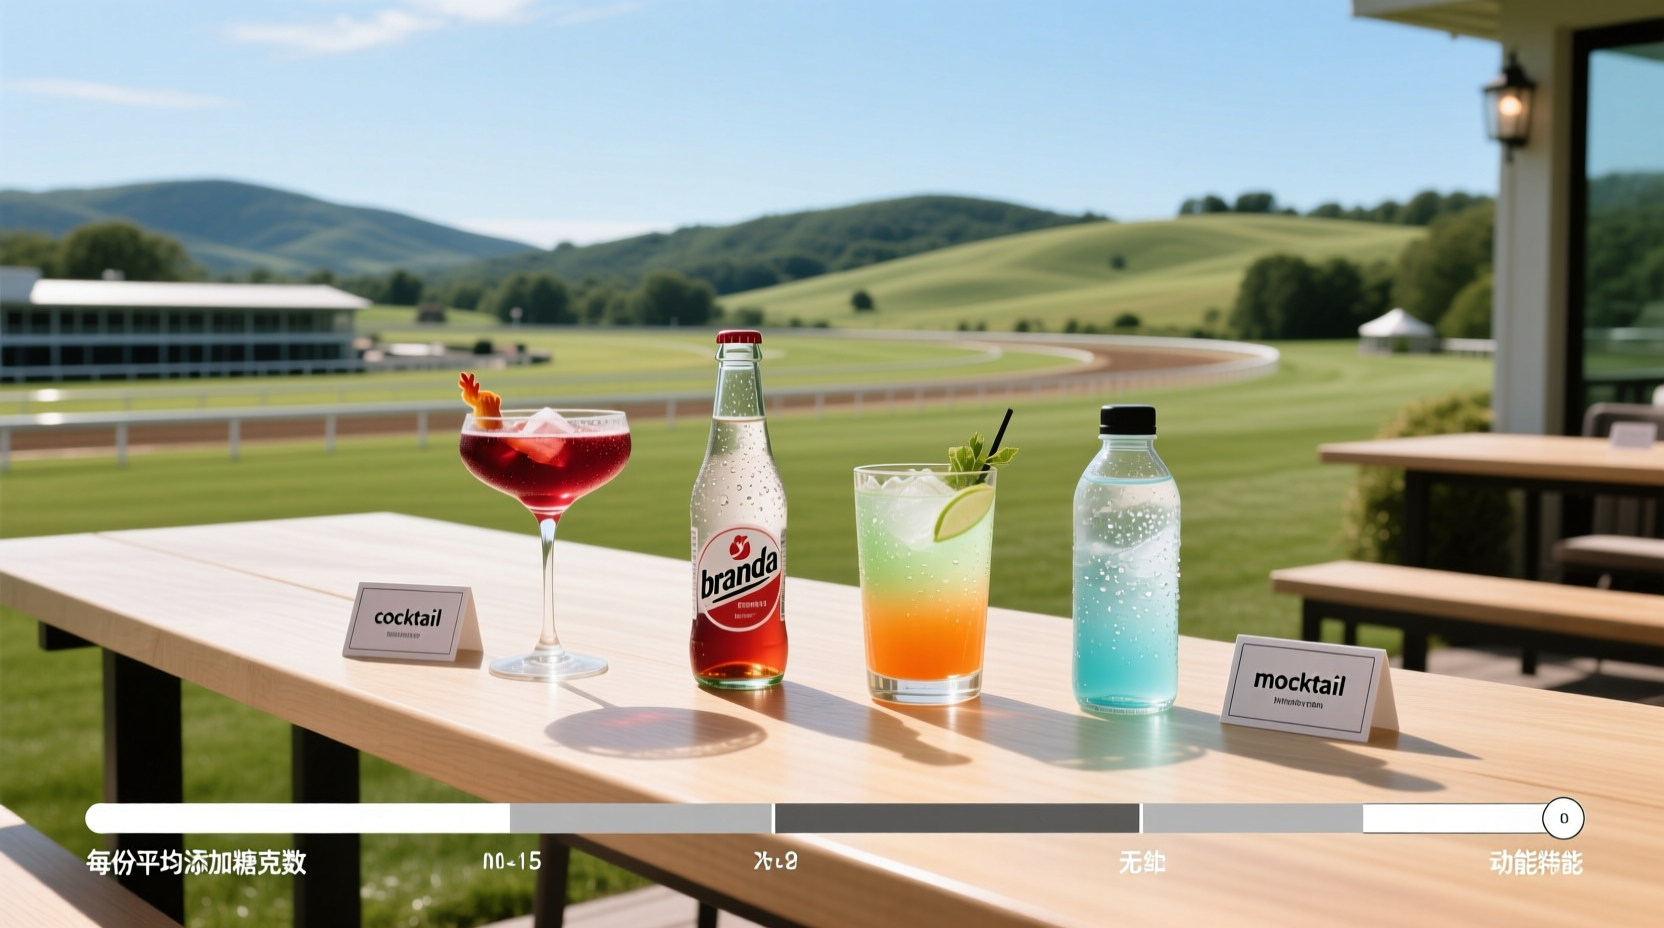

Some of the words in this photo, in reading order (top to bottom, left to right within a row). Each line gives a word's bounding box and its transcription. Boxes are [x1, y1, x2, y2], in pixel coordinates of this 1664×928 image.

[701, 546, 778, 599] branda
[374, 608, 442, 627] cocktail
[1254, 671, 1347, 697] mocktail
